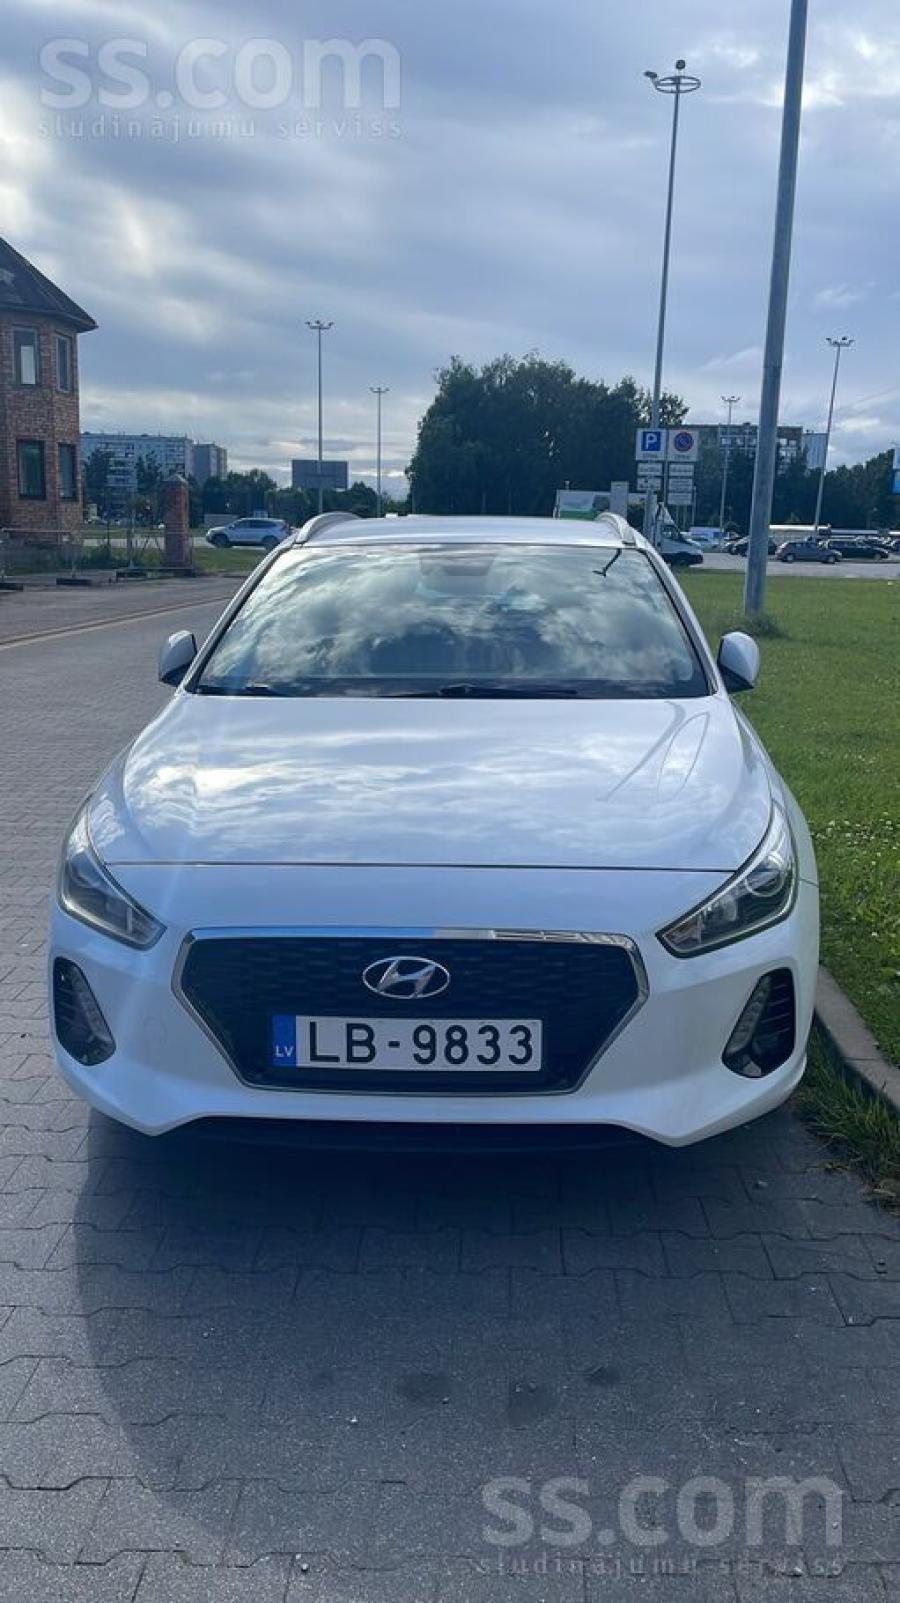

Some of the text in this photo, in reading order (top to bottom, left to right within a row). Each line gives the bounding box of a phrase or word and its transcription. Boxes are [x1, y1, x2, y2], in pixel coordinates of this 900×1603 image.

[646, 432, 658, 449] P
[275, 1046, 294, 1057] LV
[309, 1021, 533, 1065] LB-9833
